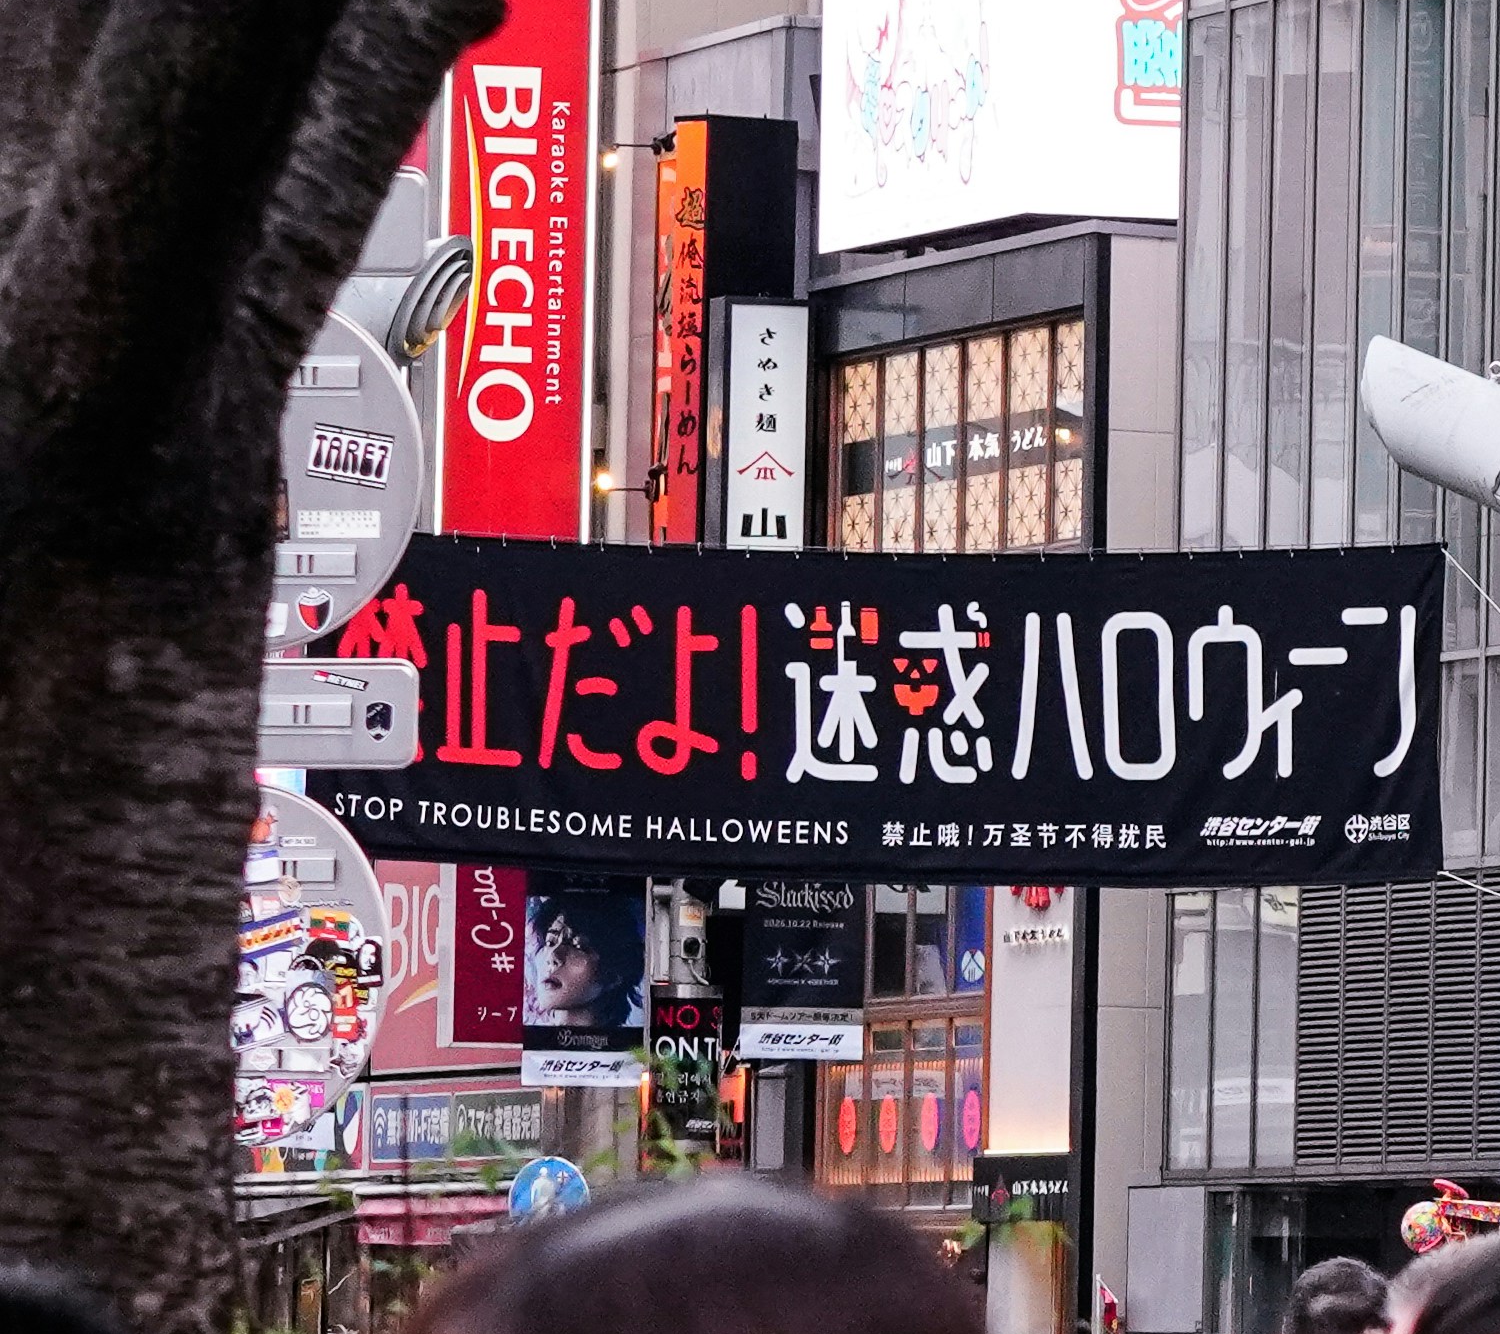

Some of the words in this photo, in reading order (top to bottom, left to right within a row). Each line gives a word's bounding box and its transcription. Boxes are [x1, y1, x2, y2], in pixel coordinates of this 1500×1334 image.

[472, 65, 542, 208] BIG
[552, 101, 571, 204] Karaoke
[467, 228, 534, 443] ECHO
[546, 217, 569, 405] Entertainment
[334, 792, 404, 821] STOP
[417, 799, 632, 839] TROUBLESOME
[646, 815, 849, 845] HALLOWEENS
[1200, 815, 1322, 837] 渋谷センター街
[1369, 813, 1411, 830] 渋谷区
[655, 1035, 699, 1061] ON
